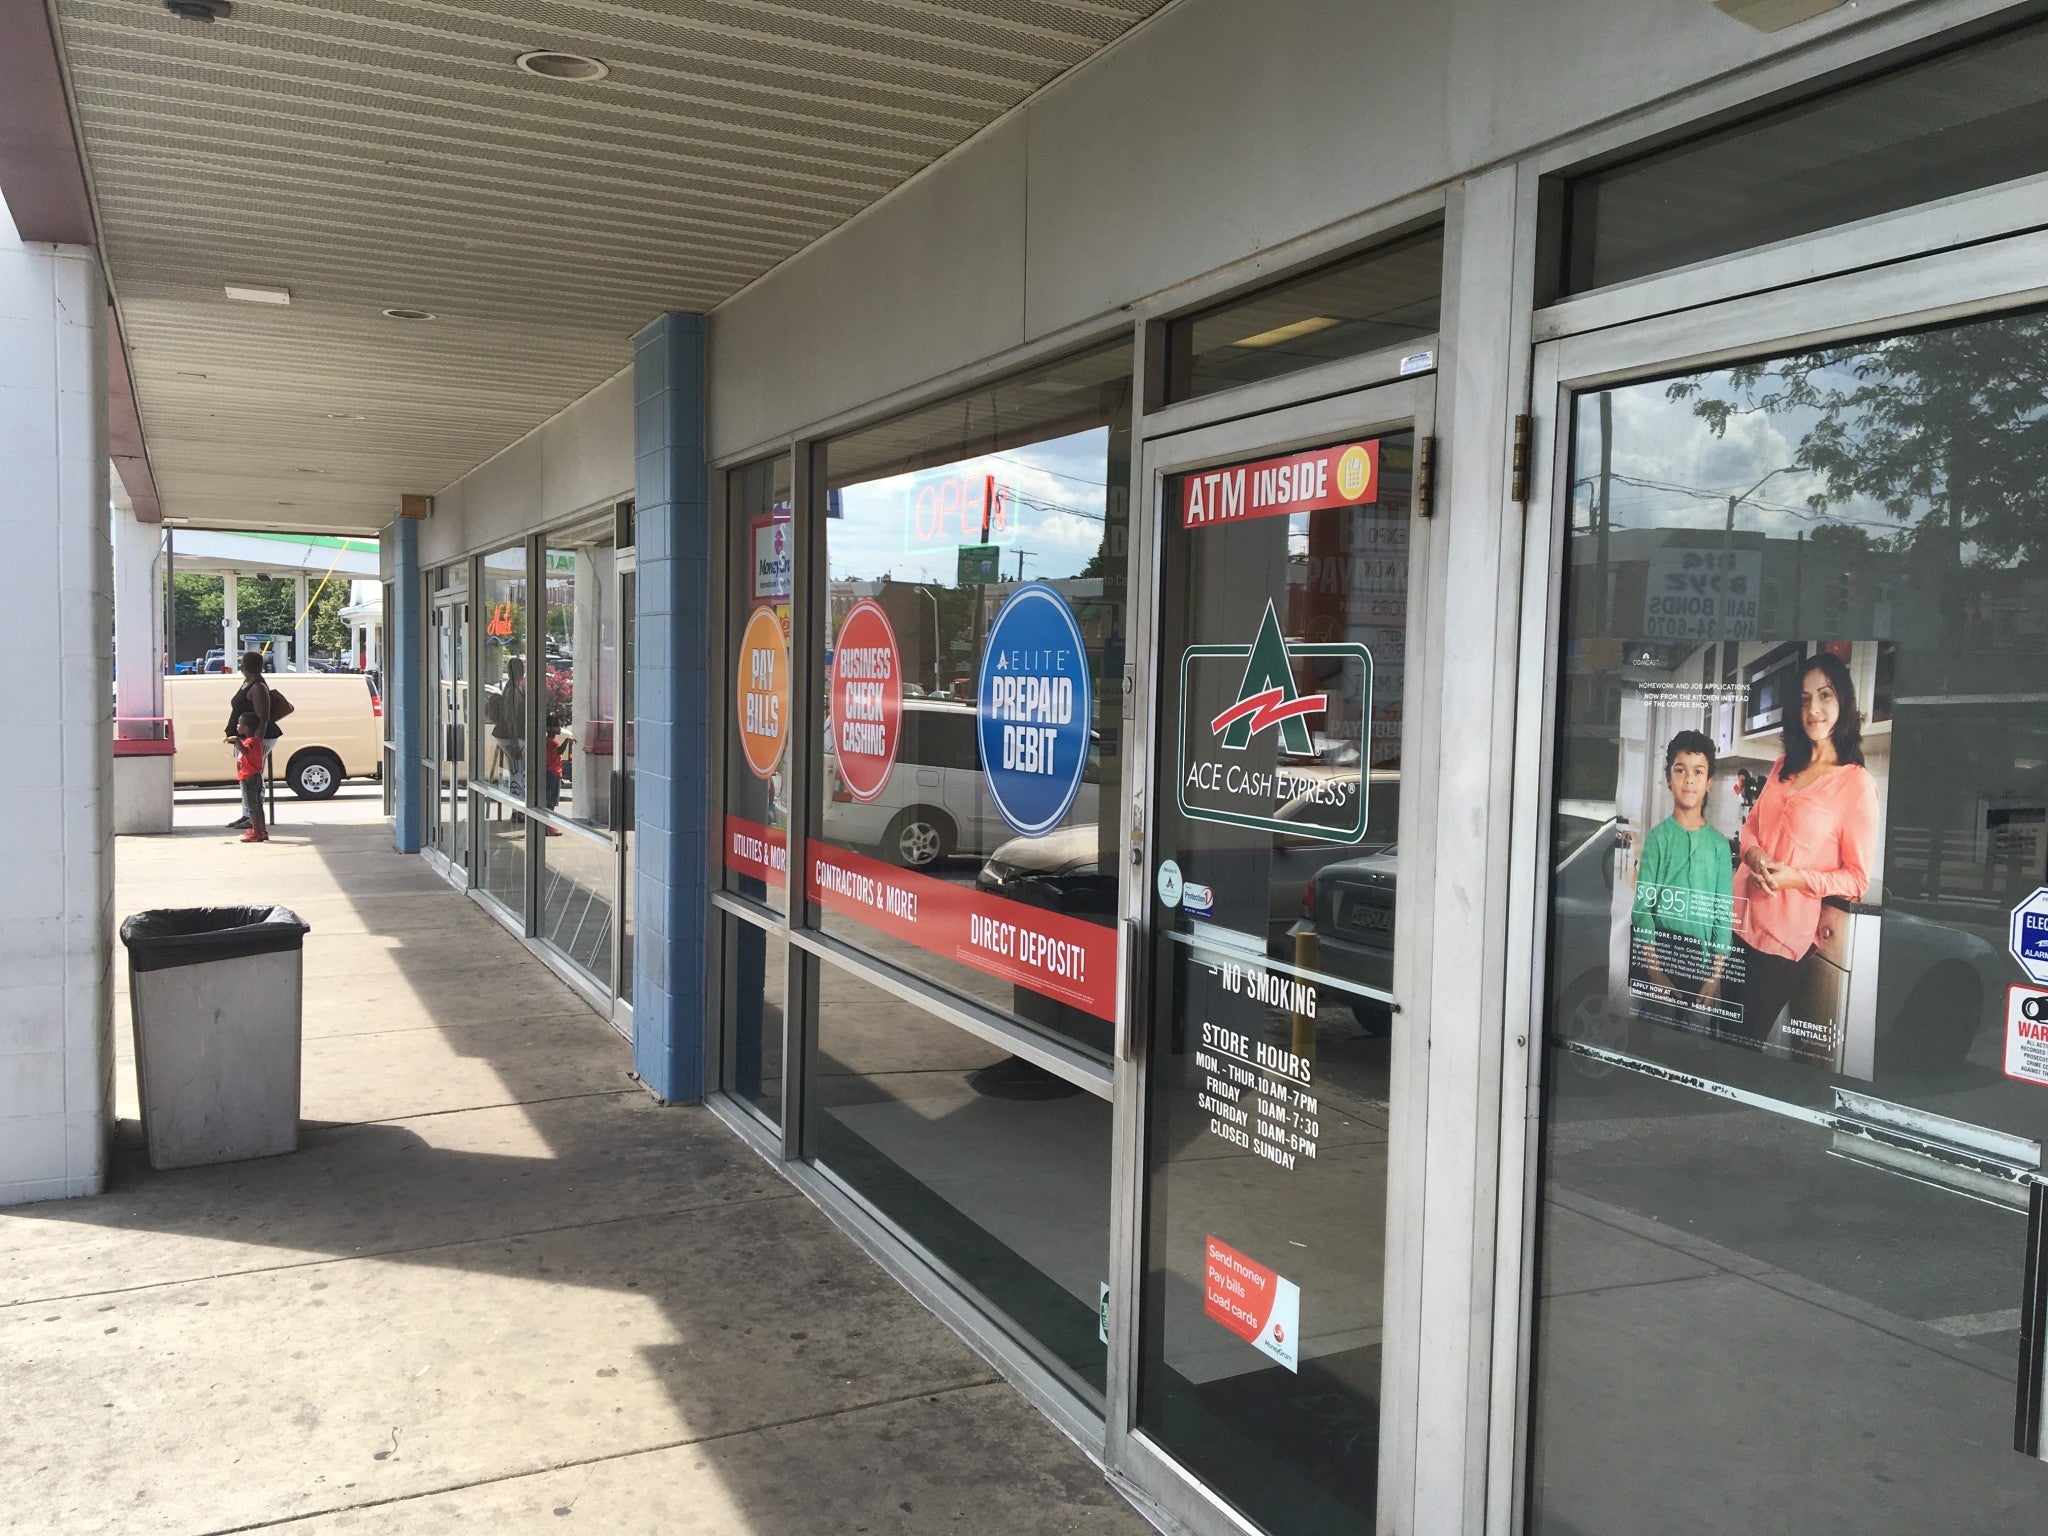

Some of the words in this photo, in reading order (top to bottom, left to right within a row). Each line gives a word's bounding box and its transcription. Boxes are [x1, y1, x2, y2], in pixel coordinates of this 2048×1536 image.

[915, 474, 1009, 540] OPEN
[1187, 468, 1246, 524] ATM
[1253, 458, 1328, 508] INSIDE
[751, 648, 775, 691] PAY
[840, 647, 891, 679] BUSINESS
[845, 682, 884, 721] CHECK
[991, 675, 1073, 725] PREPAID
[1676, 682, 1689, 690] AND
[1705, 683, 1752, 691] APPLICATIONS.
[746, 692, 779, 738] BILLS
[842, 721, 886, 757] CASHING
[1002, 724, 1057, 775] DEBIT
[1186, 761, 1222, 791] ACE
[733, 832, 763, 864] UTILITIES
[764, 842, 769, 866] &
[815, 860, 874, 906] CONTRACTORS
[876, 882, 884, 910] &
[886, 885, 918, 923] MORE!
[1636, 885, 1686, 913] $9.95
[970, 913, 1016, 958] DIRECT
[1019, 928, 1085, 983] DEPOSIT!
[1633, 926, 1652, 935] LEARN
[1653, 930, 1670, 939] MORE.
[1672, 934, 1682, 942] DO
[1704, 941, 1726, 951] SHARE
[1726, 945, 1746, 955] MORE.
[1223, 961, 1240, 993] NO
[1247, 968, 1316, 1019] SMOKING
[1632, 981, 1648, 991] APPLY
[1649, 985, 1663, 994] NOW
[1664, 988, 1671, 996] AT
[1782, 1025, 1828, 1042] ESSENTIALS
[1790, 1018, 1828, 1033] INTERNET
[1202, 1021, 1250, 1059] STORE
[1256, 1041, 1311, 1082] HOURS
[2020, 1045, 2046, 1056] RECORDED
[2026, 1060, 2041, 1069] CRIME
[1196, 1051, 1220, 1074] MON.
[1228, 1063, 1258, 1090] THUR.
[2021, 1065, 2041, 1075] AGAINST
[1207, 1075, 1240, 1103] FRIDAY
[1198, 1092, 1248, 1127] SATURDAY
[1211, 1118, 1249, 1149] CLOSED
[1253, 1138, 1295, 1171] SUNDAY
[1208, 1266, 1226, 1288] Pay
[1226, 1275, 1246, 1298] bills
[1209, 1244, 1232, 1267] Send
[1233, 1261, 1266, 1290] money
[1208, 1286, 1231, 1312] Load
[1231, 1303, 1258, 1329] cards
[1264, 1339, 1293, 1361] MoneyGram
